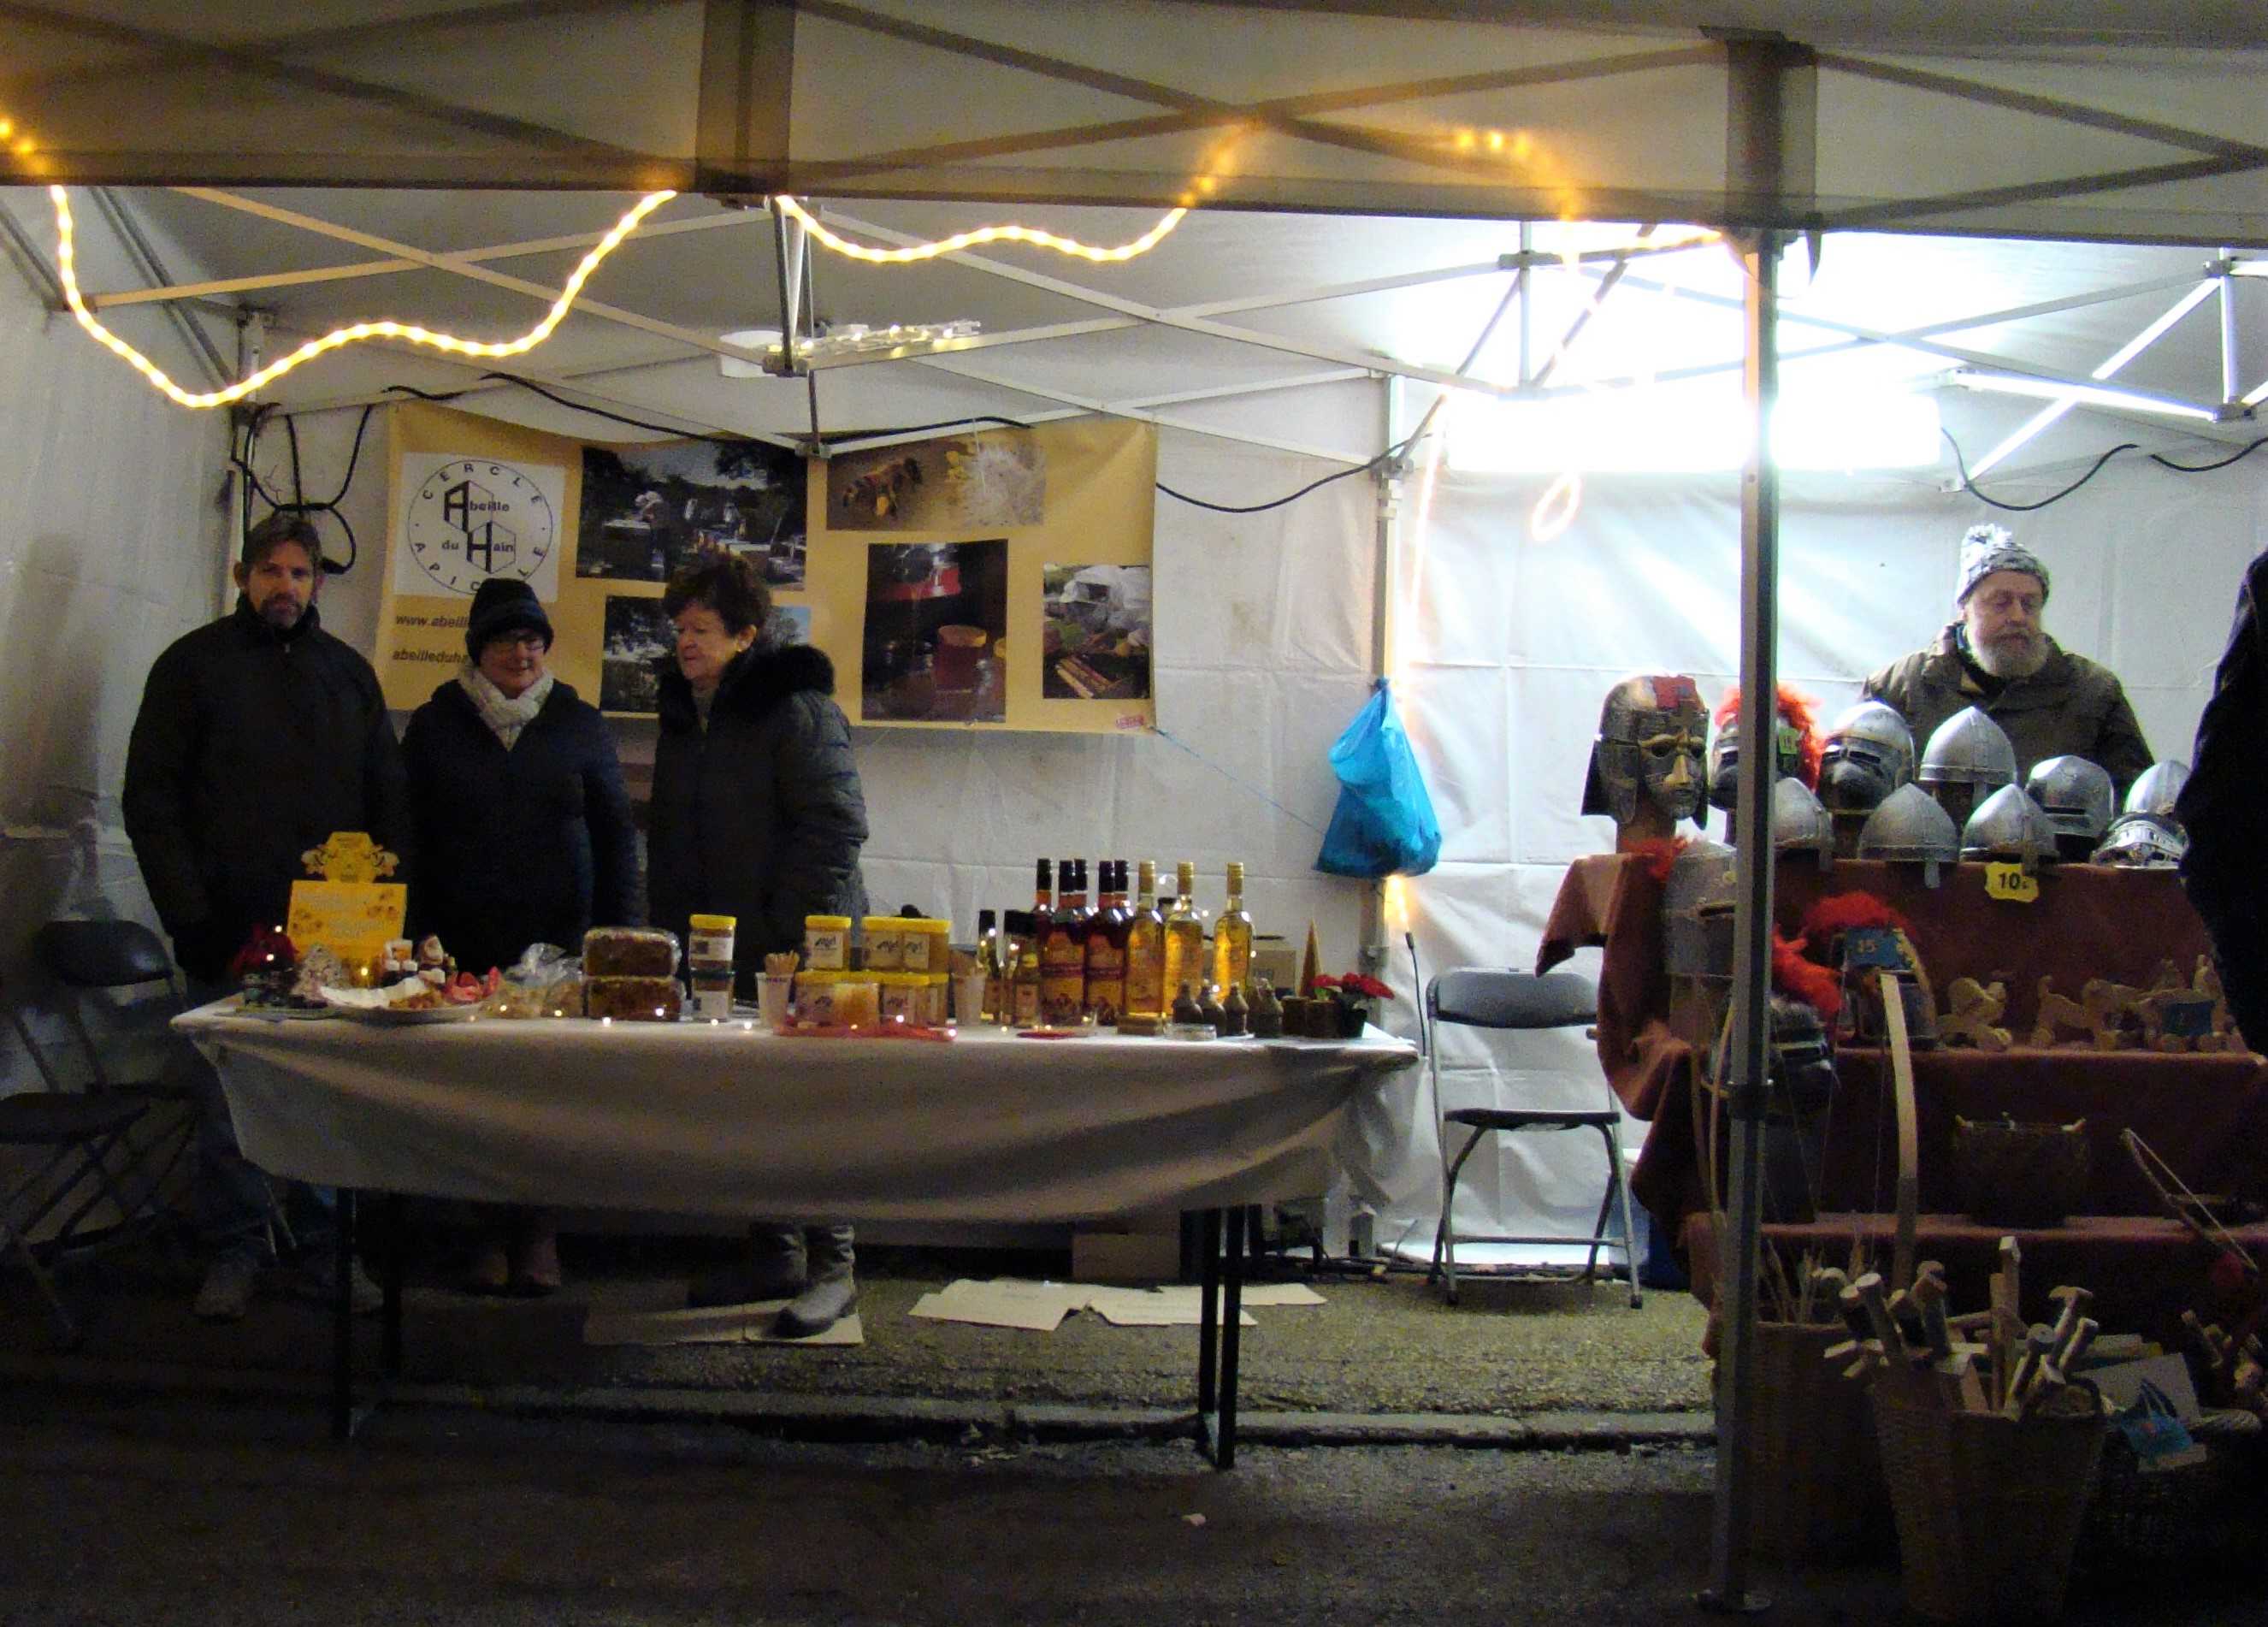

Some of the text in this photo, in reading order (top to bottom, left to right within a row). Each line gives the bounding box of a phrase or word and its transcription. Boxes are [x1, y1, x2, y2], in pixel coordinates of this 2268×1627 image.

[422, 463, 543, 504] CERCLE
[414, 541, 546, 592] APICLE
[441, 520, 515, 575] du Hain
